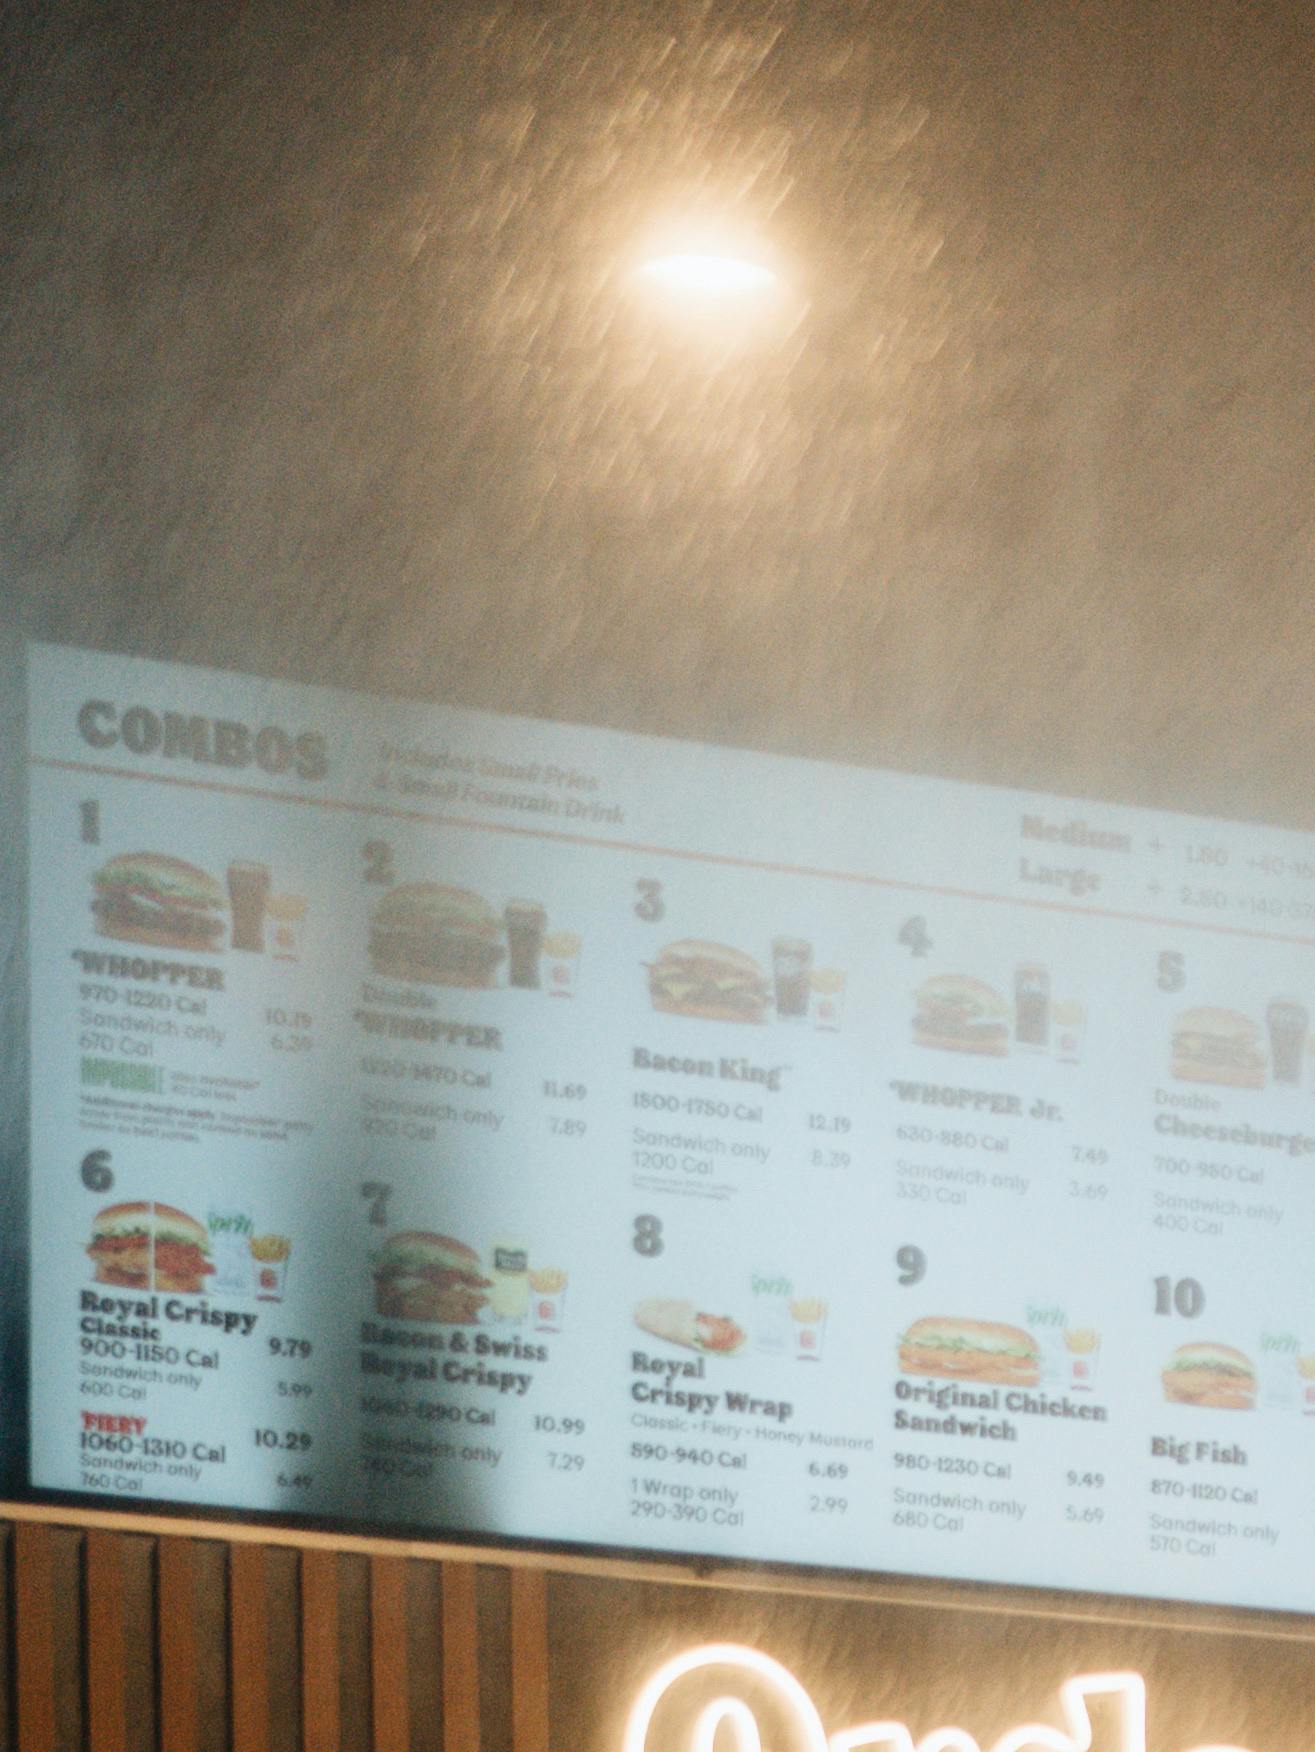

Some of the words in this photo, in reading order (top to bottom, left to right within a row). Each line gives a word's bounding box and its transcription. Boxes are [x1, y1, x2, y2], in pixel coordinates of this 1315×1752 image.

[77, 698, 330, 782] COMBOS
[462, 782, 560, 816] Fountain
[564, 797, 626, 825] Drink
[80, 799, 100, 845] 1
[1019, 813, 1132, 854] Medium
[361, 838, 394, 885] 2
[1018, 856, 1100, 897] Large
[634, 878, 667, 923] 3
[897, 915, 933, 958] 4
[71, 949, 226, 992] WHOPPER
[1156, 949, 1187, 992] 5
[175, 995, 207, 1016] Cal
[79, 1007, 179, 1036] Sandwich
[184, 1025, 226, 1048] only
[354, 1008, 503, 1052] WHOPPER
[119, 1036, 154, 1057] Cal
[631, 1046, 715, 1078] Bacon
[461, 1067, 493, 1090] Cal
[542, 1079, 589, 1101] 11.69
[361, 1093, 458, 1123] Sandwich
[463, 1106, 505, 1134] only
[735, 1103, 763, 1123] Cal
[889, 1079, 1023, 1117] WHOPPER
[1029, 1097, 1065, 1123] Jr.
[1153, 1087, 1222, 1112] Double
[808, 1112, 851, 1134] 12.19
[632, 1126, 727, 1156] Sandwich
[731, 1142, 771, 1165] only
[981, 1133, 1010, 1153] Cal
[79, 1148, 115, 1193] 6
[632, 1149, 677, 1172] 1200
[682, 1153, 714, 1176] Cal
[896, 1157, 987, 1188] Sandwich
[991, 1172, 1031, 1196] only
[1236, 1166, 1265, 1185] Cal
[360, 1180, 393, 1228] 7
[935, 1185, 967, 1206] Cal
[1153, 1189, 1242, 1218] Sandwich
[1246, 1203, 1284, 1227] only
[632, 1213, 664, 1259] 8
[1153, 1212, 1188, 1233] 400
[1193, 1216, 1224, 1237] Cal
[895, 1242, 927, 1287] 9
[80, 1289, 159, 1321] Royal
[164, 1299, 258, 1336] Crispy
[1153, 1274, 1206, 1319] 10
[79, 1316, 161, 1342] Classic
[360, 1321, 446, 1350] Bacon
[449, 1331, 469, 1353] &
[473, 1333, 548, 1363] Swiss
[79, 1338, 180, 1366] 900-1150
[185, 1350, 220, 1370] Cal
[268, 1336, 313, 1360] 9.79
[79, 1360, 164, 1385] Sandwich
[167, 1373, 203, 1392] only
[360, 1351, 438, 1383] Royal
[442, 1361, 534, 1397] Crispy
[631, 1350, 705, 1388] Royal
[117, 1384, 147, 1401] Cal
[630, 1380, 719, 1413] Crispy
[723, 1391, 793, 1423] Wrap
[893, 1379, 999, 1411] Original
[1004, 1390, 1108, 1423] Chicken
[80, 1410, 148, 1436] FIERY
[465, 1405, 497, 1427] Cal
[533, 1413, 586, 1436] 10.99
[630, 1411, 688, 1433] Classic
[701, 1417, 742, 1441] Fiery
[755, 1425, 806, 1448] Honey
[808, 1432, 874, 1452] Mustard
[893, 1408, 1018, 1442] Sandwich
[80, 1431, 188, 1460] 1060-1310
[192, 1443, 227, 1464] Cal
[254, 1428, 313, 1452] 10.29
[1150, 1434, 1190, 1466] Big
[1194, 1440, 1249, 1467] Fish
[79, 1452, 164, 1476] Sandwich
[167, 1463, 203, 1483] only
[460, 1446, 503, 1470] only
[547, 1450, 586, 1472] 7.29
[718, 1450, 747, 1470] Cal
[807, 1460, 849, 1480] 6.69
[893, 1451, 979, 1477] 980-1230
[982, 1460, 1012, 1480] Cal
[631, 1476, 639, 1493] 1
[642, 1477, 696, 1502] Wrap
[698, 1485, 739, 1505] only
[1065, 1469, 1105, 1489] 9.49
[1150, 1477, 1228, 1502] 870-1120
[1231, 1487, 1259, 1506] Cal
[630, 1498, 706, 1521] 290-390
[712, 1507, 745, 1527] Cal
[809, 1493, 849, 1515] 2.99
[892, 1486, 984, 1513] Sandwich
[988, 1498, 1027, 1522] only
[1065, 1503, 1105, 1524] 5.69
[892, 1510, 928, 1530] 680
[932, 1512, 964, 1533] Cal
[1149, 1511, 1239, 1537] Sandwich
[1242, 1523, 1280, 1548] only
[1149, 1534, 1182, 1554] 570
[1185, 1538, 1217, 1557] Cal
